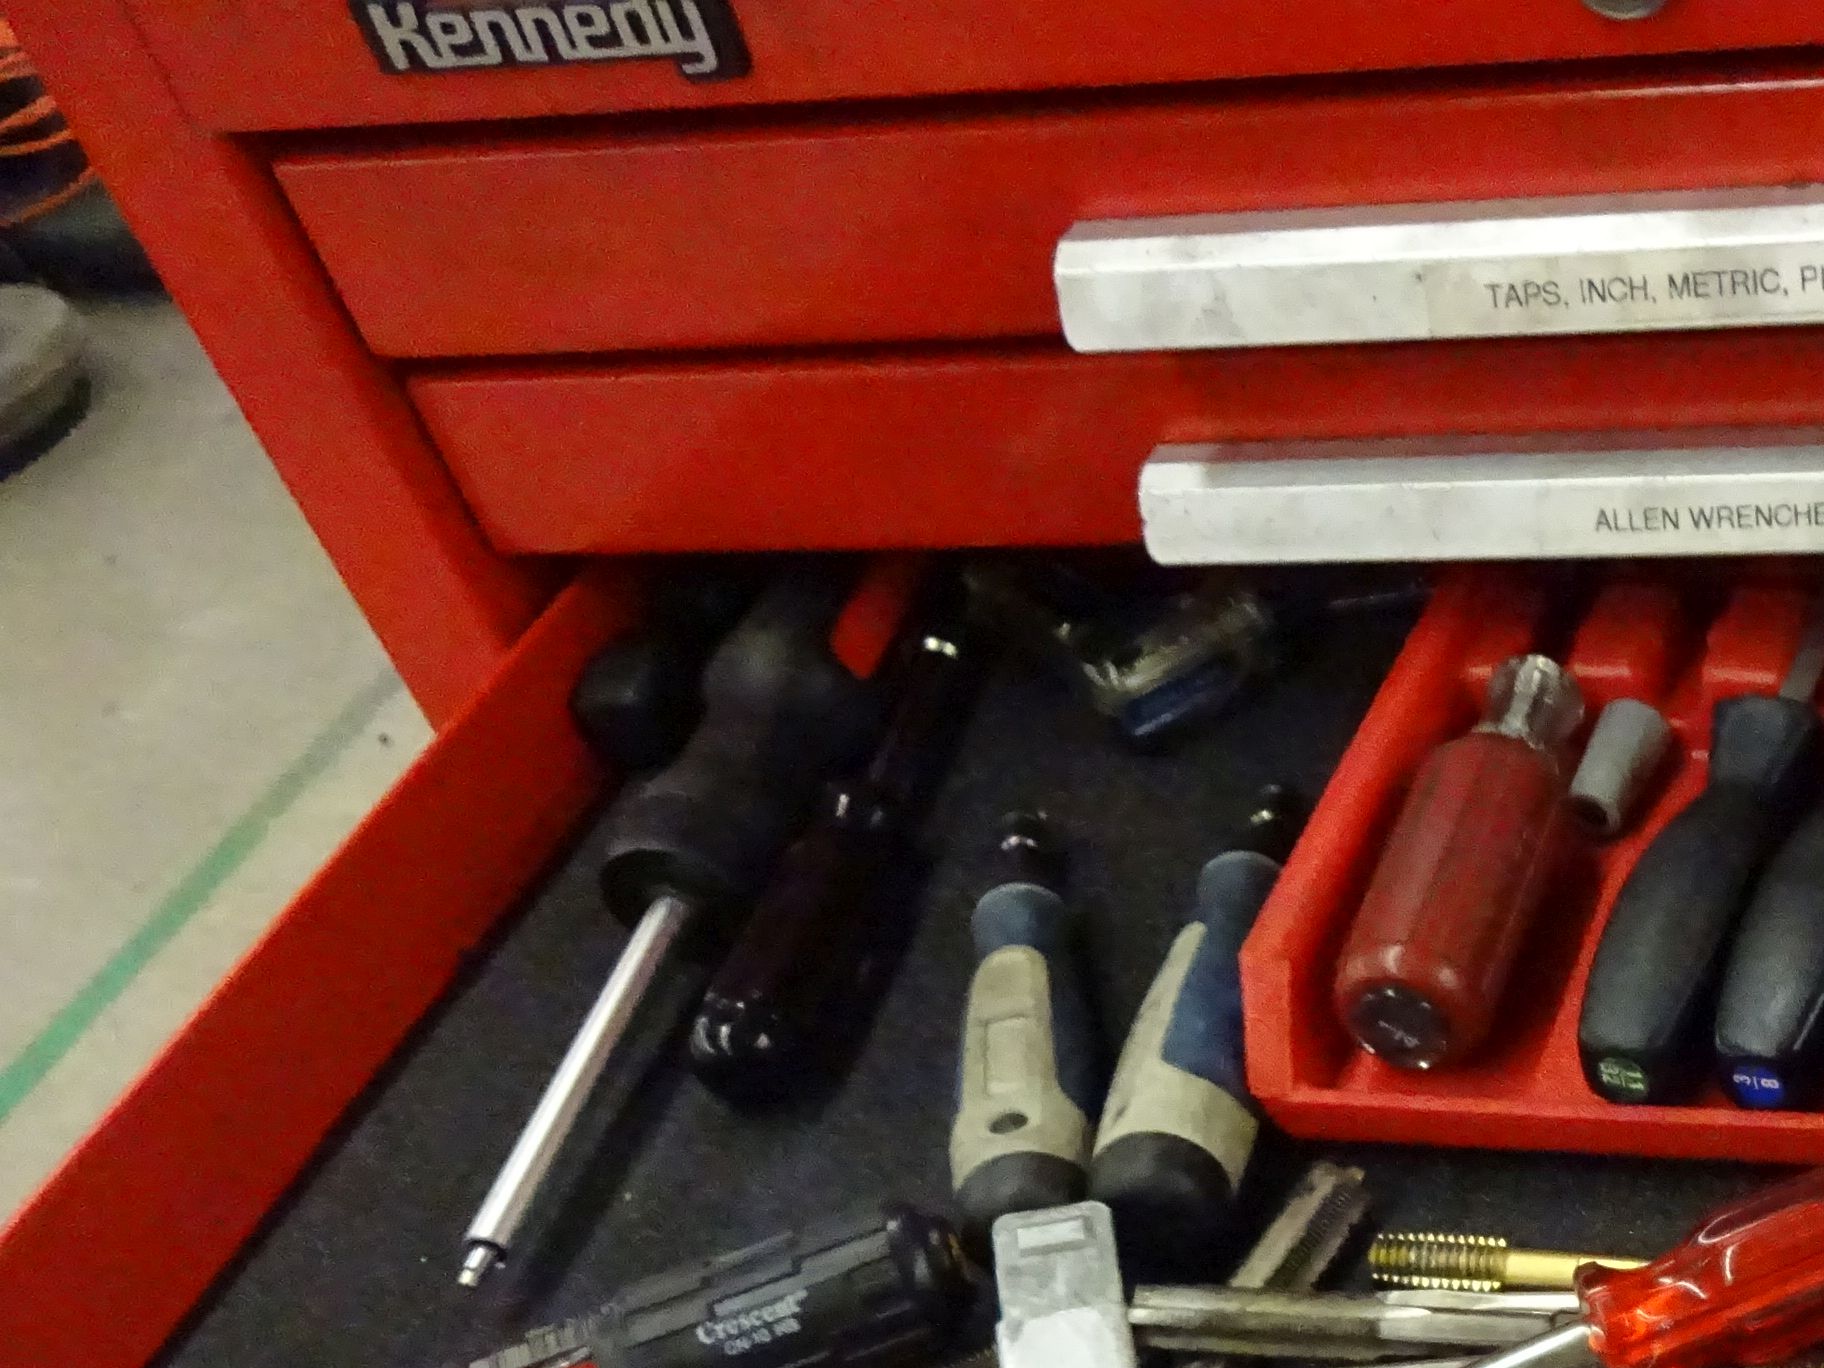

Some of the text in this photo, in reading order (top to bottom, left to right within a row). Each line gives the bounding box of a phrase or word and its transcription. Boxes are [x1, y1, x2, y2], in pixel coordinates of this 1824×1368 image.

[368, 0, 718, 75] Kennedy
[1485, 280, 1569, 310] TAPS,
[1580, 275, 1656, 304] INCH,
[1668, 268, 1788, 300] METRIC,
[1595, 507, 1680, 532] ALLEN
